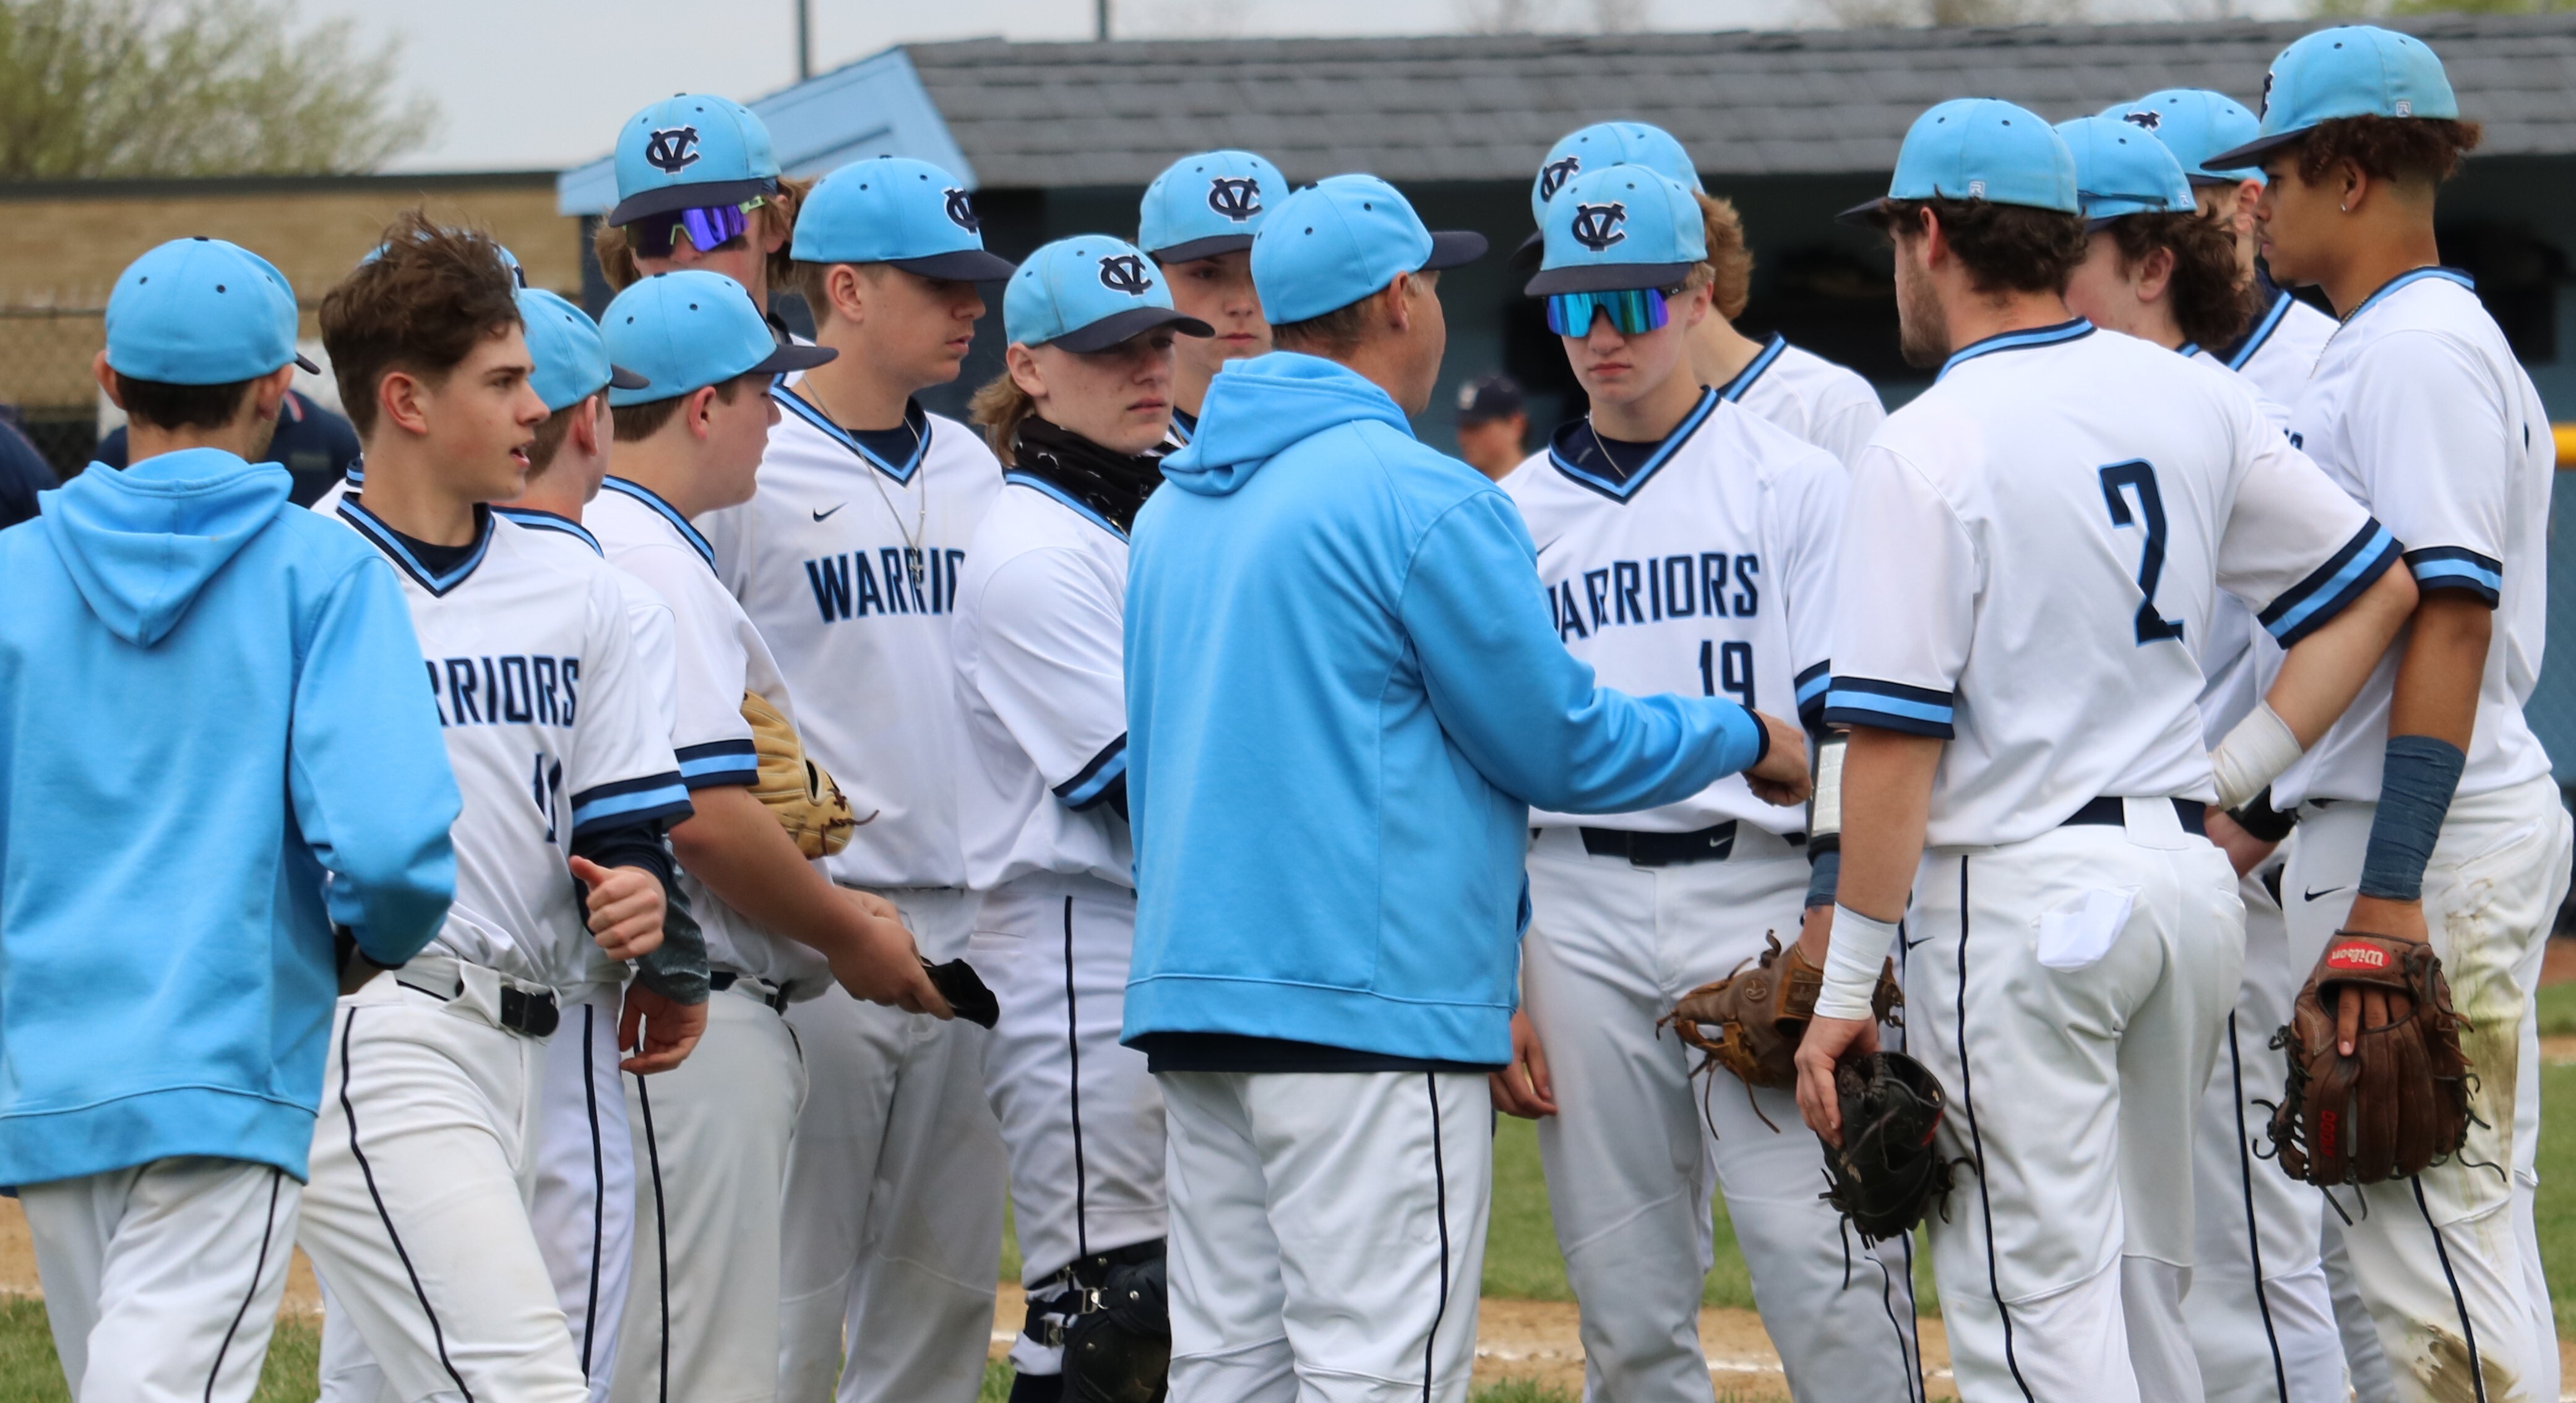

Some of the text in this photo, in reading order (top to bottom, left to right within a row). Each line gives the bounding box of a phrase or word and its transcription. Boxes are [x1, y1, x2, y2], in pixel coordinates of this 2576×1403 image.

[2097, 457, 2184, 647] 2
[1698, 640, 1756, 709] 19
[2331, 947, 2384, 968] Wilson
